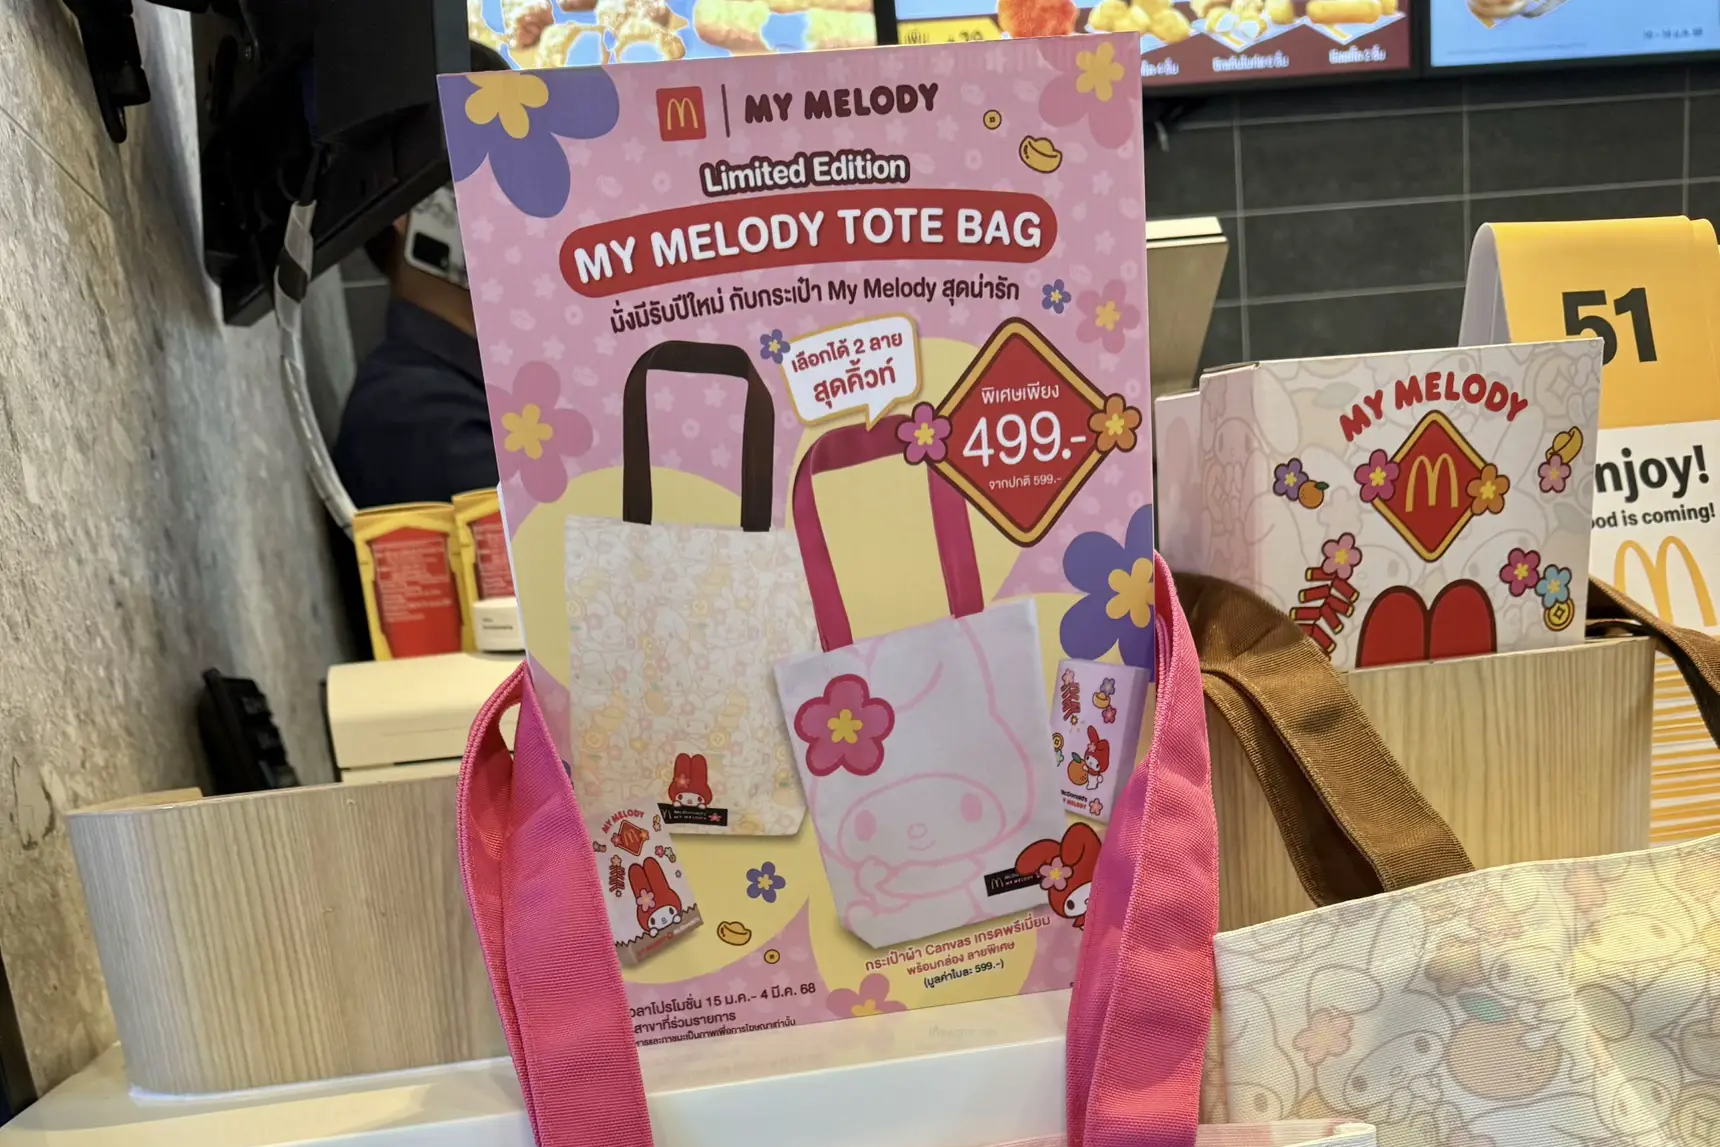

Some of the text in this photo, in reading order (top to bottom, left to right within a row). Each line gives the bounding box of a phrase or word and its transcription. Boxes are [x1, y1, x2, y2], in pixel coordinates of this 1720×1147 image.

[745, 82, 939, 124] MY MELODY
[703, 153, 906, 193] Limited Edition
[573, 207, 1042, 285] MY MELODY TOTE BAG
[610, 273, 1020, 334] มั่งมีรับปีใหม่ กับกระเป๋า My Melody สุดน่ารัก
[1561, 286, 1658, 367] 51
[791, 332, 903, 373] เลือกได้ 2 ลาย
[813, 356, 896, 409] สุดคิ้วท์
[981, 381, 1060, 405] พิเศษเพียง
[1339, 371, 1529, 442] MY MELODY
[962, 410, 1087, 468] 499.-
[988, 473, 1062, 491] จากปกติ 599.-
[1622, 508, 1639, 527] is
[1643, 501, 1717, 526] coming!
[610, 808, 645, 824] MELODY
[865, 912, 1051, 972] กระเป๋าผ้า Canvas เกรดพรีเมี่ยม
[906, 940, 1016, 977] พร้อมกล่อง ลายพิเศษ
[974, 958, 1005, 974] 599.-)
[706, 994, 722, 1008] 15
[760, 988, 769, 1000] 4
[771, 984, 798, 999] มี.ค.
[799, 982, 816, 996] 68
